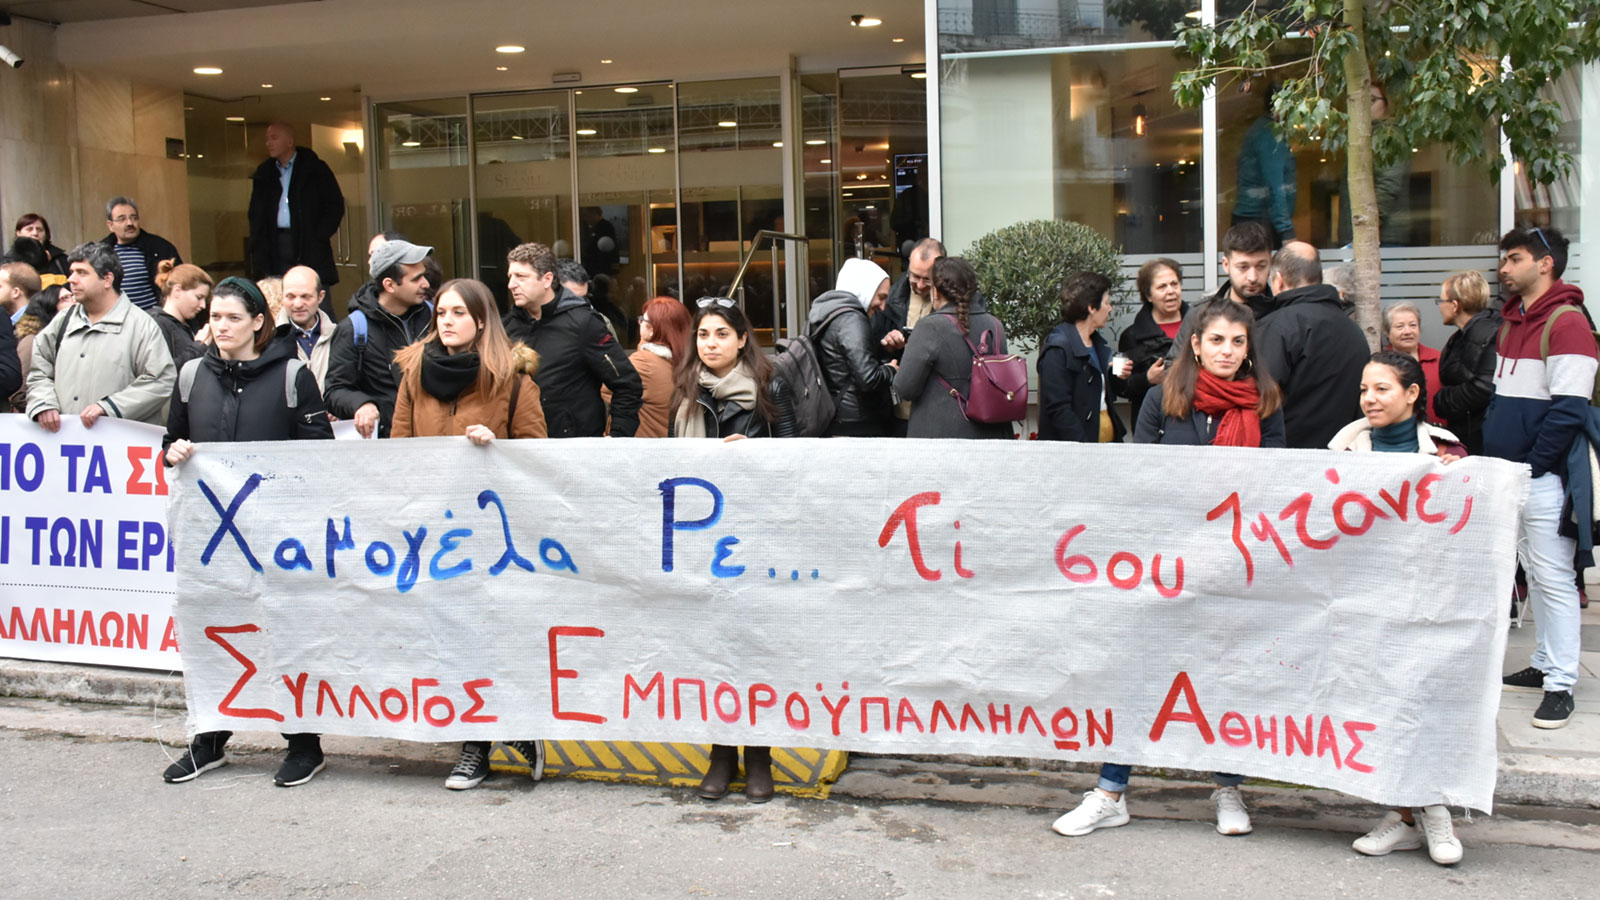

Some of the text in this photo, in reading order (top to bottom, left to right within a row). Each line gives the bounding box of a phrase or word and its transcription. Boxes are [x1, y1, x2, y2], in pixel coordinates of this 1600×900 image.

[61, 445, 112, 493] ΤΑ
[26, 517, 102, 568] ΤΩΝ
[197, 474, 578, 593] Χαμογέλα
[1055, 525, 1185, 598] σου
[1149, 671, 1376, 773] ΑΘΗΝΑΣ
